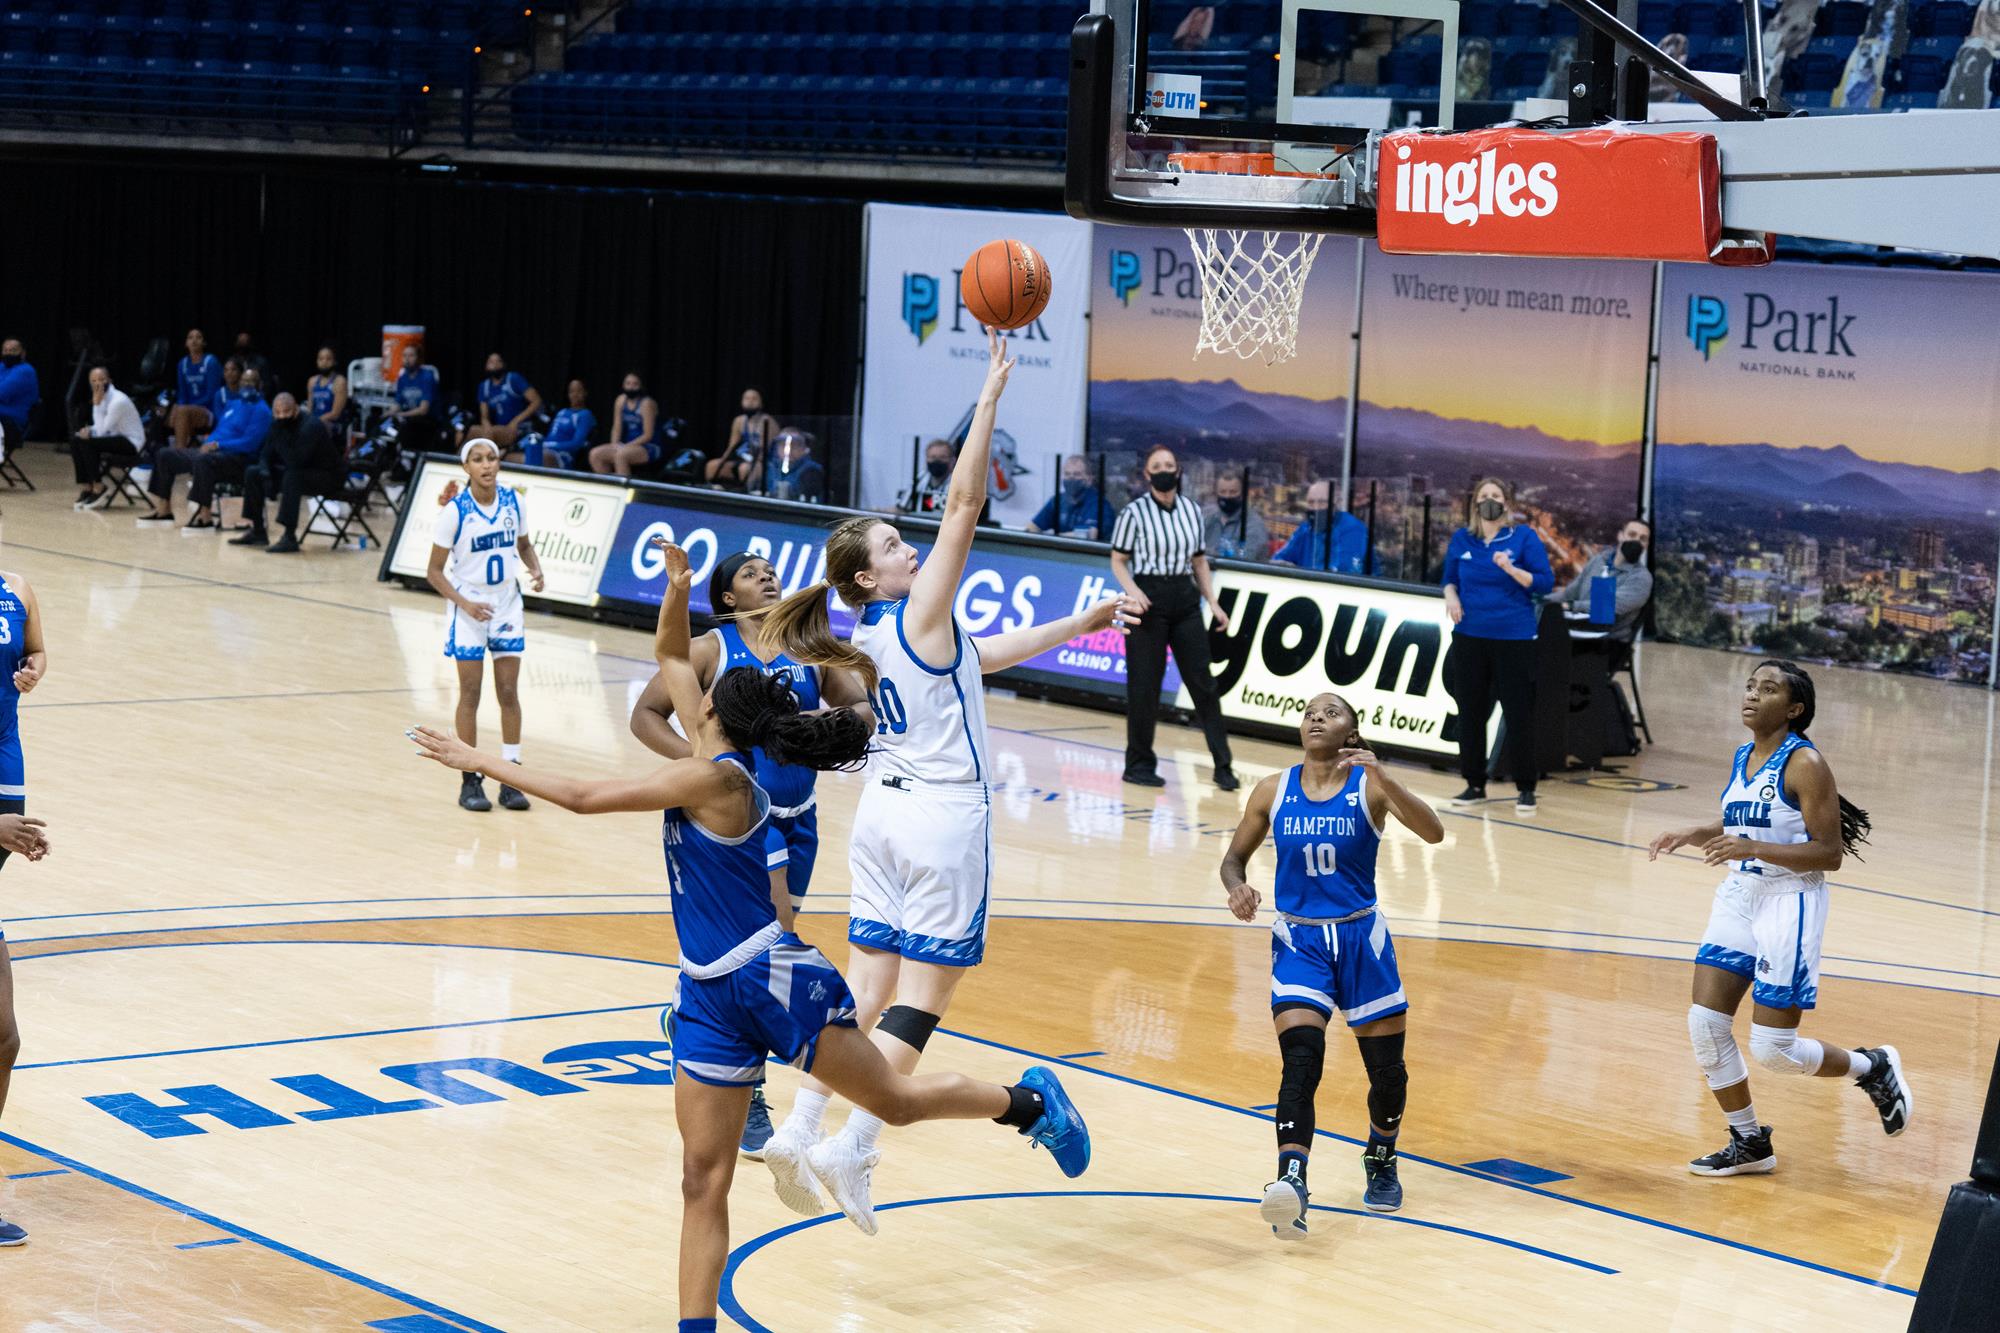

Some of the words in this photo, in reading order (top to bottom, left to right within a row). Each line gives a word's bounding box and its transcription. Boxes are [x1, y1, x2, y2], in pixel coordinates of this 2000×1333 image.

[1395, 145, 1559, 227] ingles
[1392, 273, 1460, 302] Where
[1461, 285, 1500, 312] you
[1506, 288, 1564, 314] mean
[1570, 295, 1632, 320] more.
[1740, 292, 1858, 357] Park
[1018, 354, 1052, 368] BANK
[1739, 361, 1811, 378] NATIONAL
[1816, 367, 1857, 381] BANK
[533, 530, 598, 565] Hilton
[631, 521, 718, 588] GO
[486, 553, 505, 587] 0
[1057, 649, 1112, 672] CASINO
[1200, 586, 1460, 741] youn
[1372, 705, 1386, 726] &
[1390, 708, 1436, 734] tours
[1283, 816, 1356, 837] HAMPTON
[1303, 842, 1336, 877] 10
